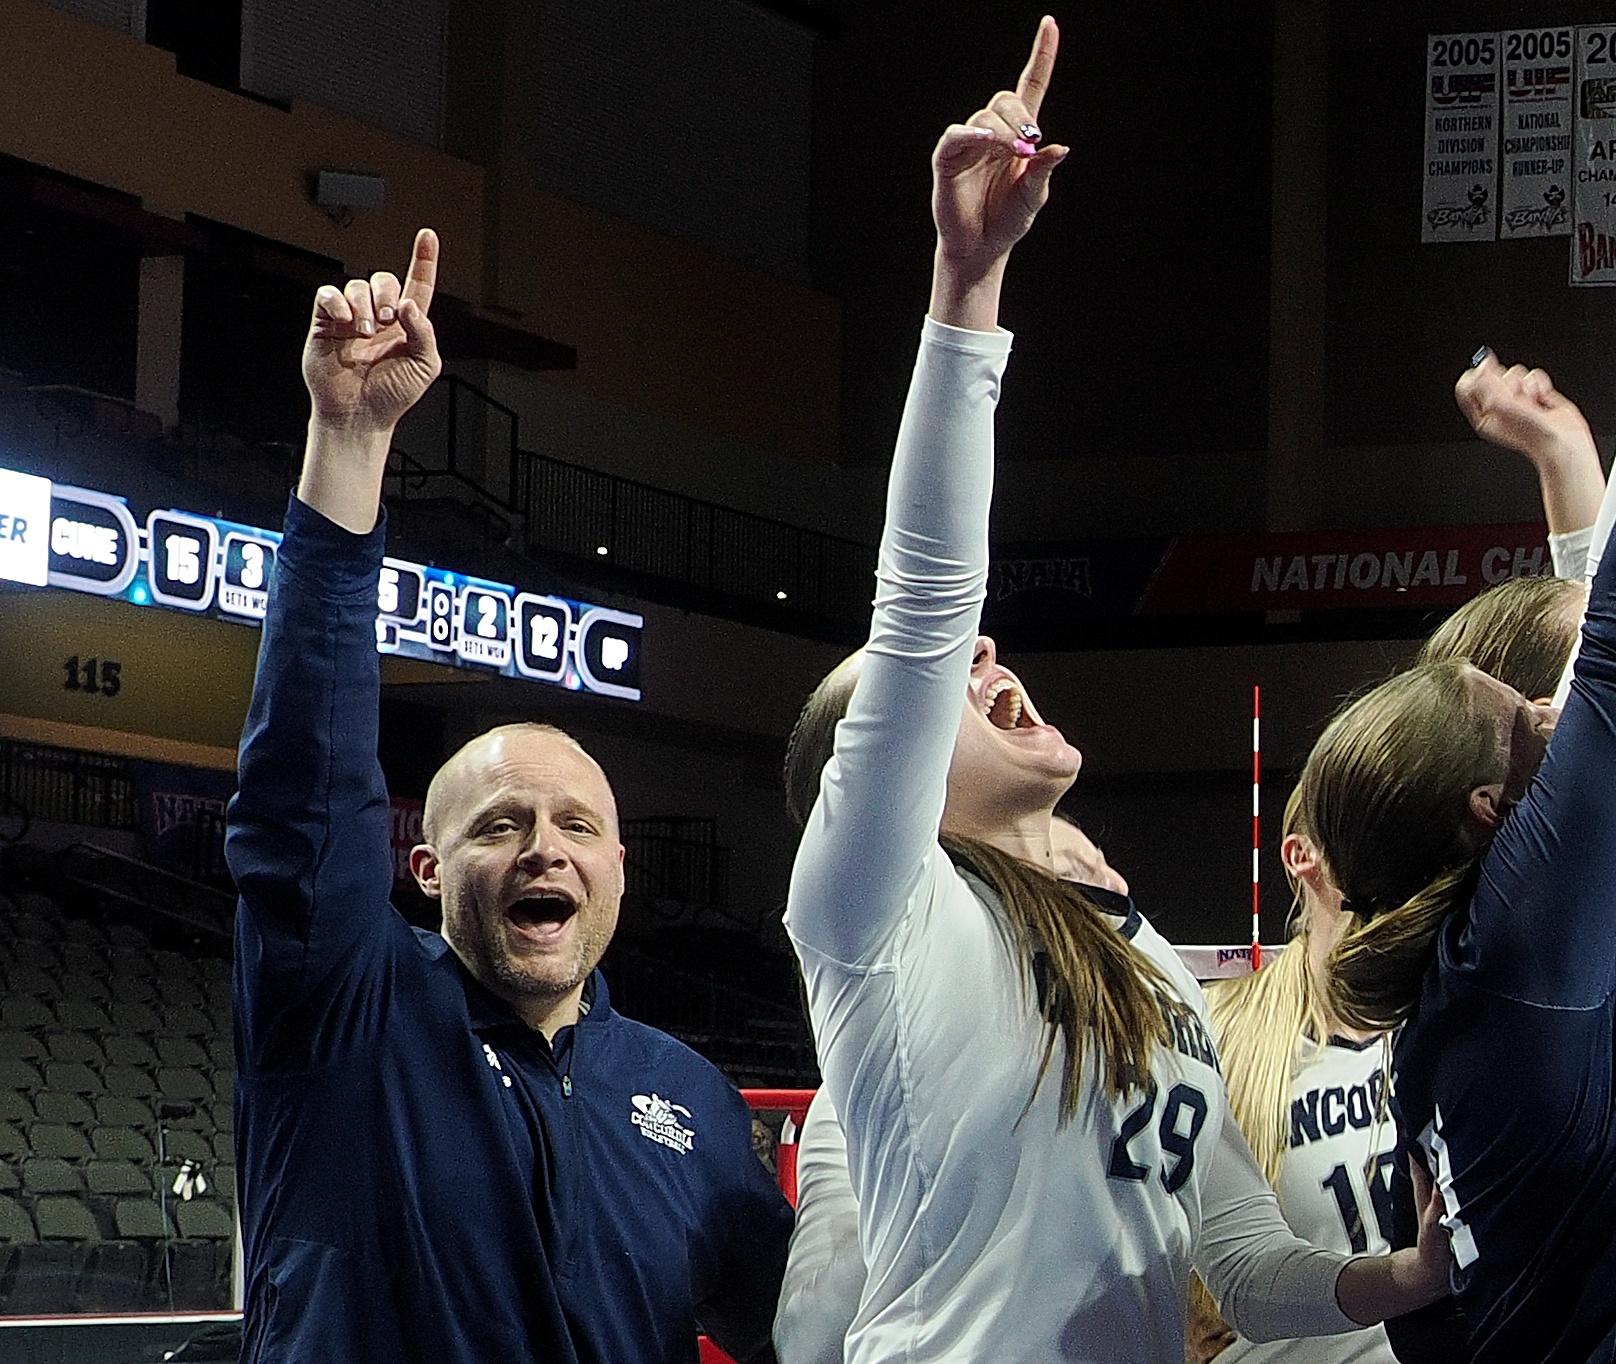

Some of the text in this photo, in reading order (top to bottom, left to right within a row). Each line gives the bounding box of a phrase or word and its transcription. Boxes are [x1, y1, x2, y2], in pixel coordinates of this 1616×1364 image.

[1432, 38, 1495, 66] 2005
[1507, 31, 1571, 61] 2005
[1438, 138, 1484, 154] DIVISION
[1429, 159, 1493, 176] CHAMPIONS
[165, 534, 200, 585] 15
[240, 542, 264, 588] 3
[1250, 548, 1467, 593] NATIONAL
[477, 596, 497, 638] 2
[530, 614, 559, 659] 12
[64, 656, 121, 697] 115
[631, 1111, 693, 1150] CONCORDIA
[1105, 1082, 1207, 1194] 29
